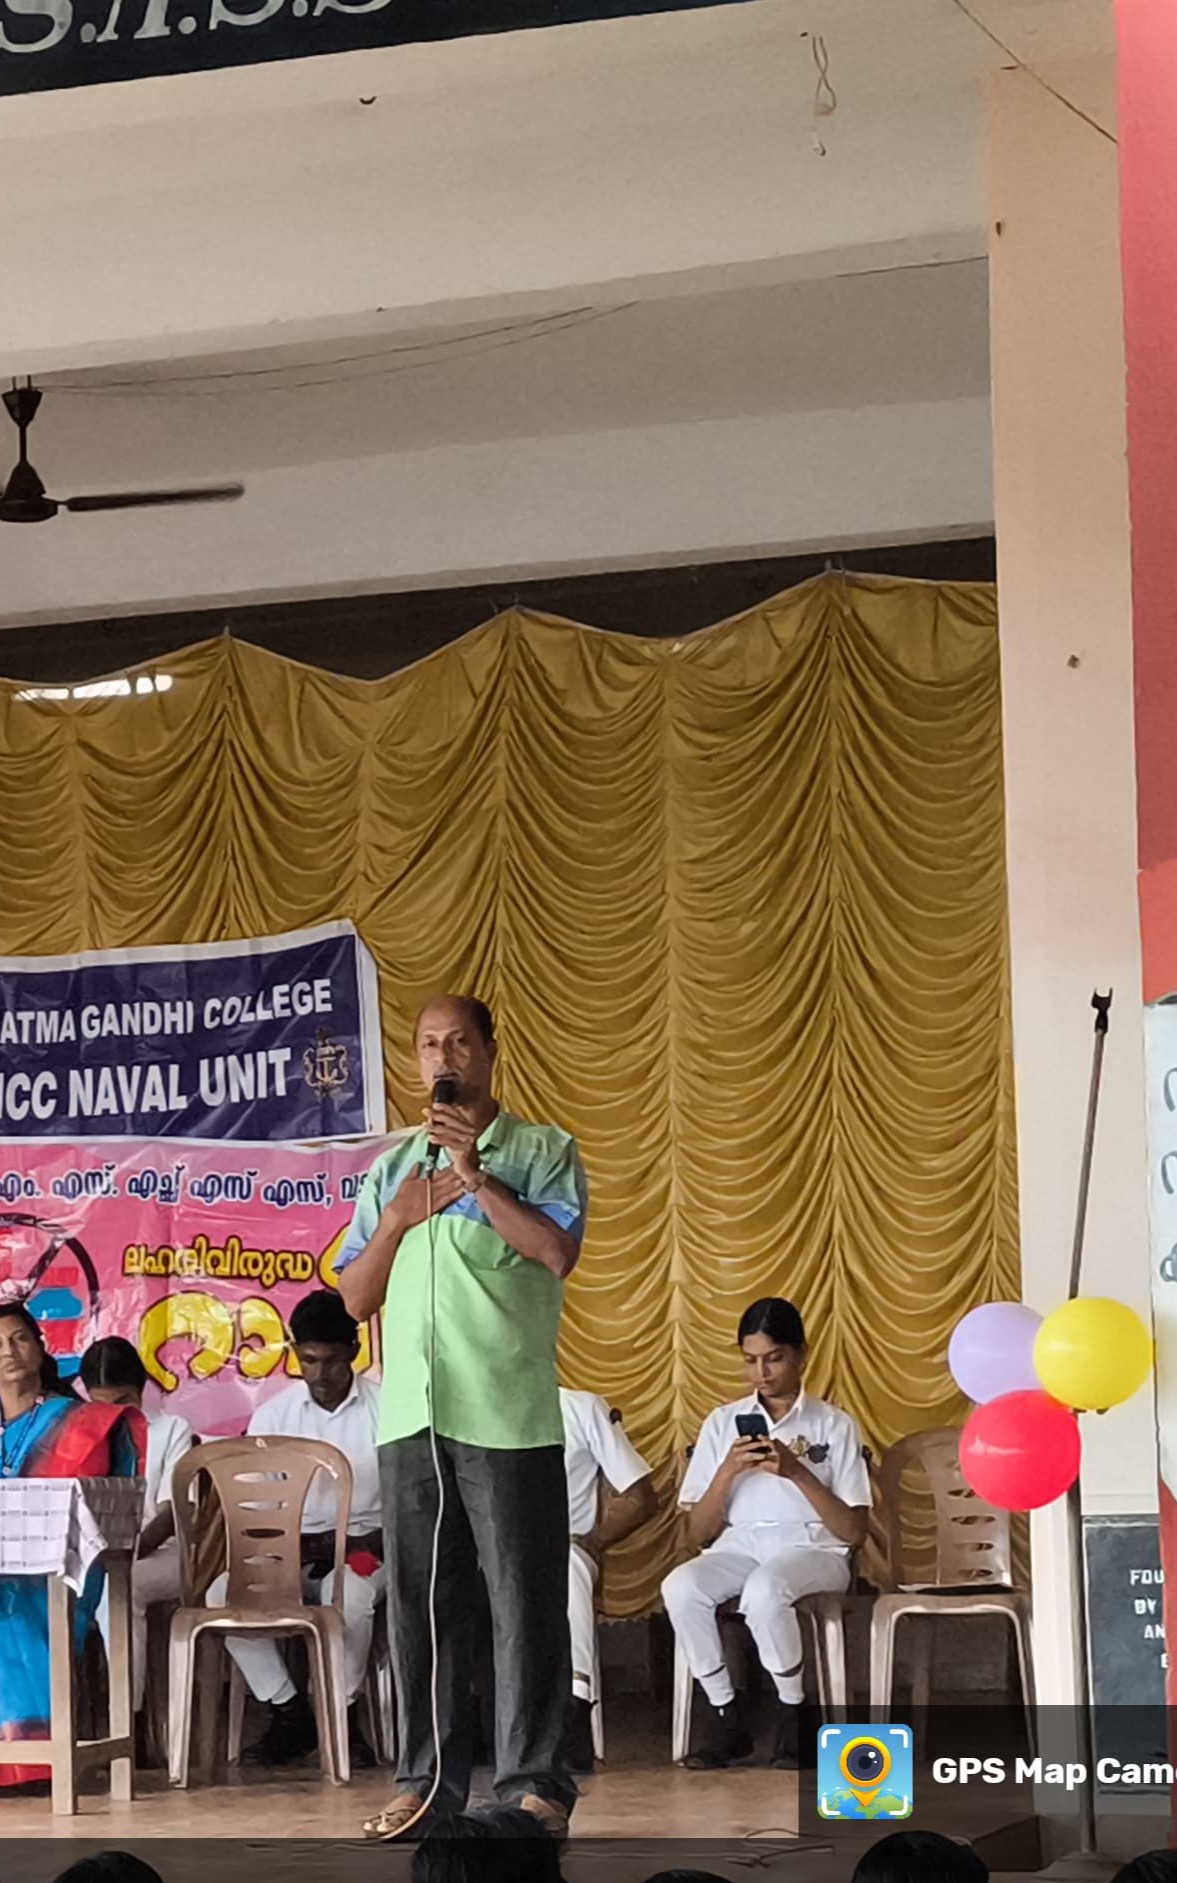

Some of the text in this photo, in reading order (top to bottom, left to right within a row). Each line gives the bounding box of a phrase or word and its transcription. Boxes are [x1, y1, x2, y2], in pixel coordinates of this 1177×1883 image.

[81, 1001, 194, 1039] GANDHI
[204, 979, 332, 1029] COLLEGE
[68, 1064, 188, 1118] NAVAL
[199, 1047, 291, 1106] UNIT
[190, 1171, 258, 1203] എസ്
[1134, 1598, 1157, 1615] BY
